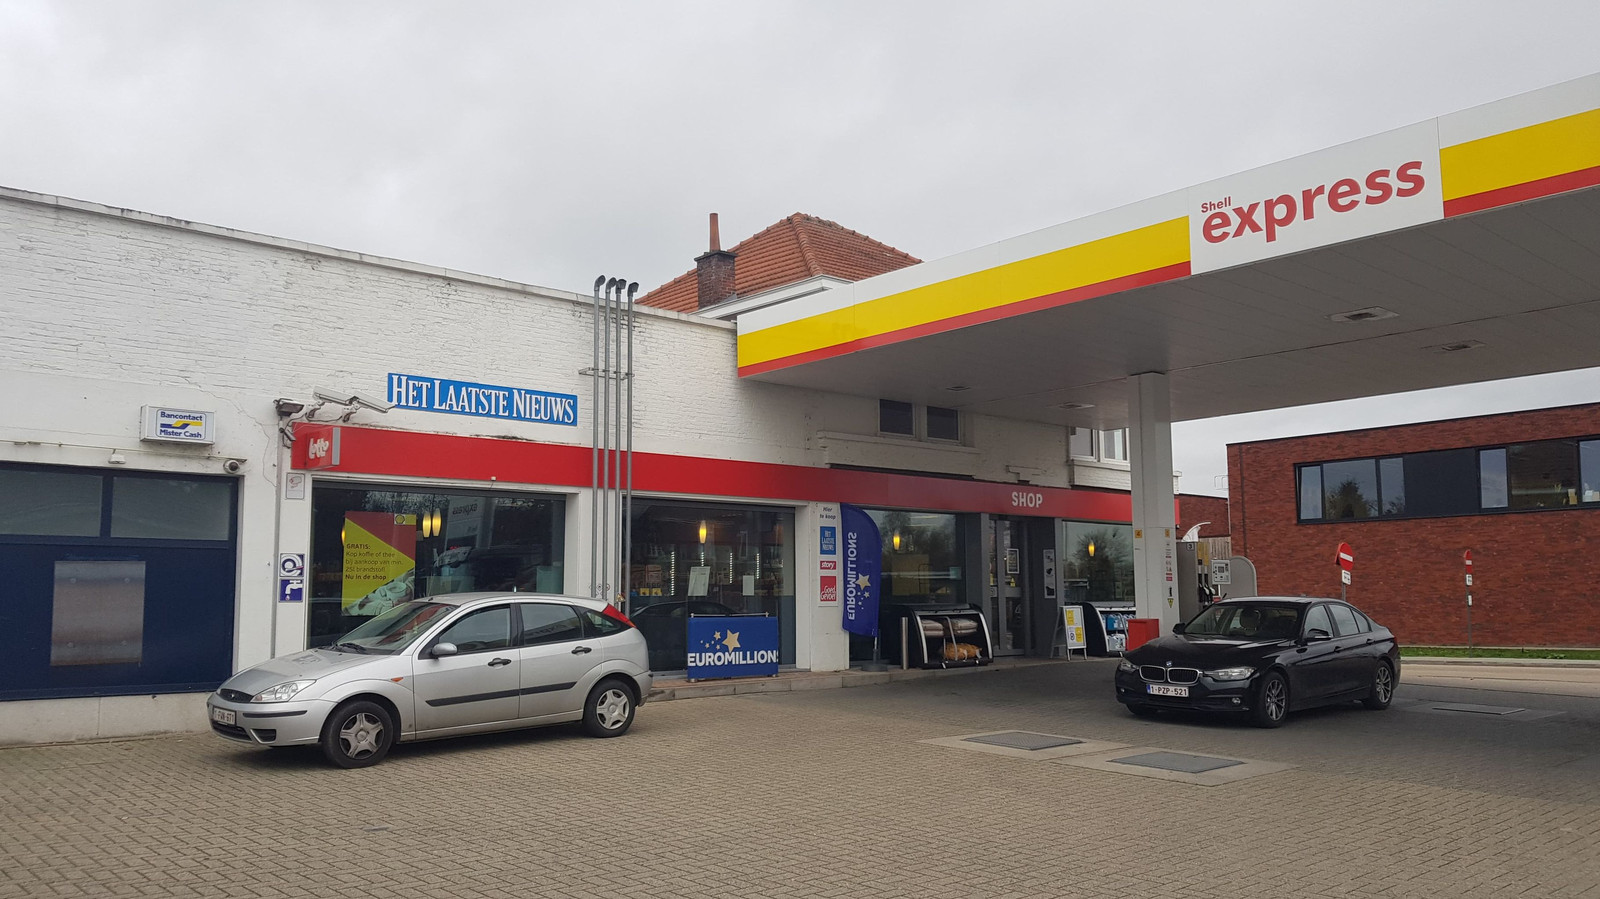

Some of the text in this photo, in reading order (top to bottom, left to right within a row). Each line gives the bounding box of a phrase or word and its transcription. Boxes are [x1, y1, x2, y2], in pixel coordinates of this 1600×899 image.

[1201, 196, 1231, 213] Shell
[1202, 160, 1426, 244] express
[391, 375, 575, 424] HET LAATSTE NIEUWS
[160, 411, 203, 422] Bancontact
[159, 428, 202, 439] Mister Cash
[1011, 491, 1043, 508] SHOP
[821, 561, 835, 569] story
[1150, 685, 1188, 696] 1-PZP-521
